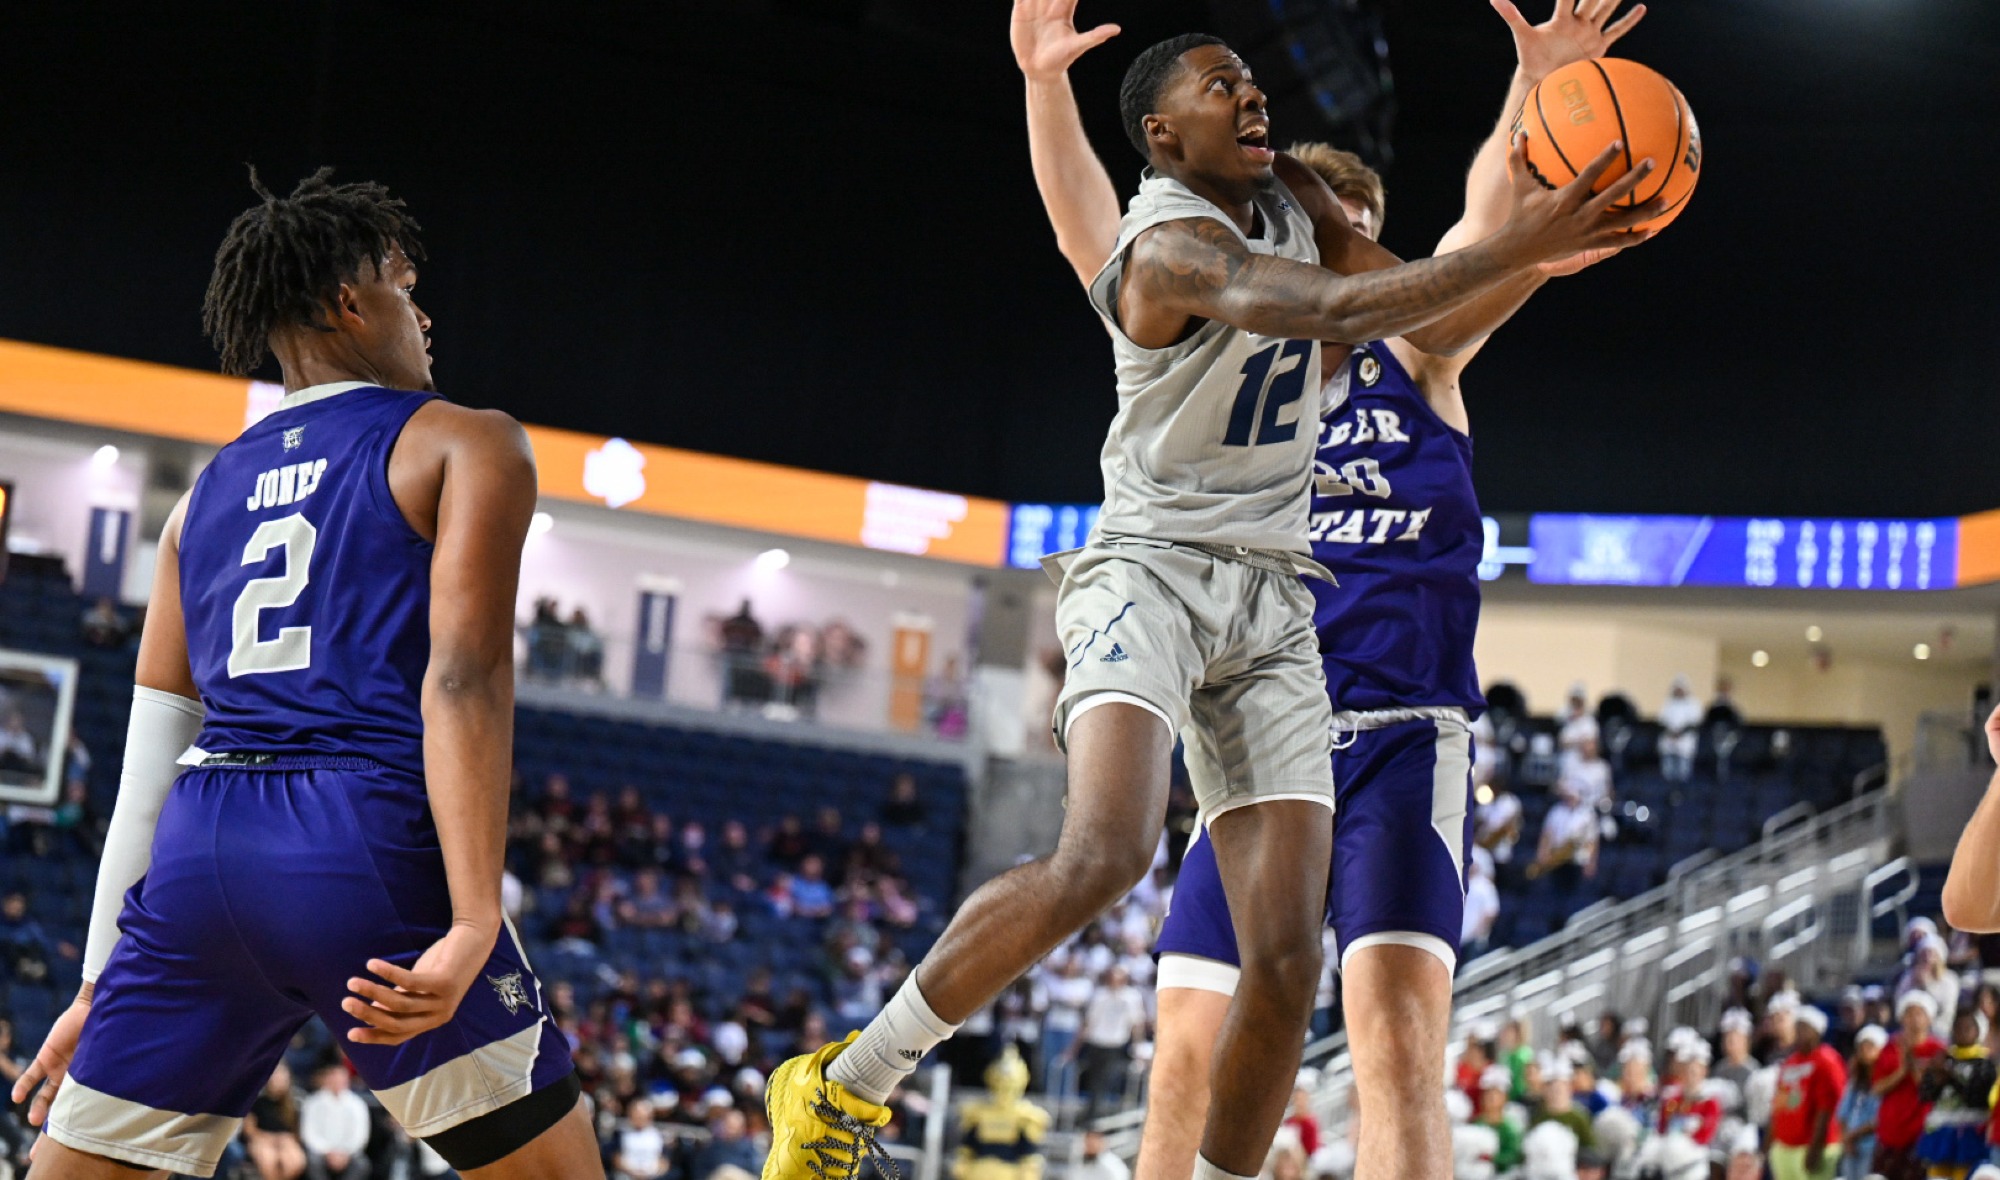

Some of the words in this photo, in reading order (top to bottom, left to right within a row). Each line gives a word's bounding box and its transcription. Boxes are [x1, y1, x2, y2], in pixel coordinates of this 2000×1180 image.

[1221, 339, 1313, 447] 12
[247, 458, 328, 512] JONES
[1308, 506, 1432, 543] TATE
[226, 511, 317, 679] 2
